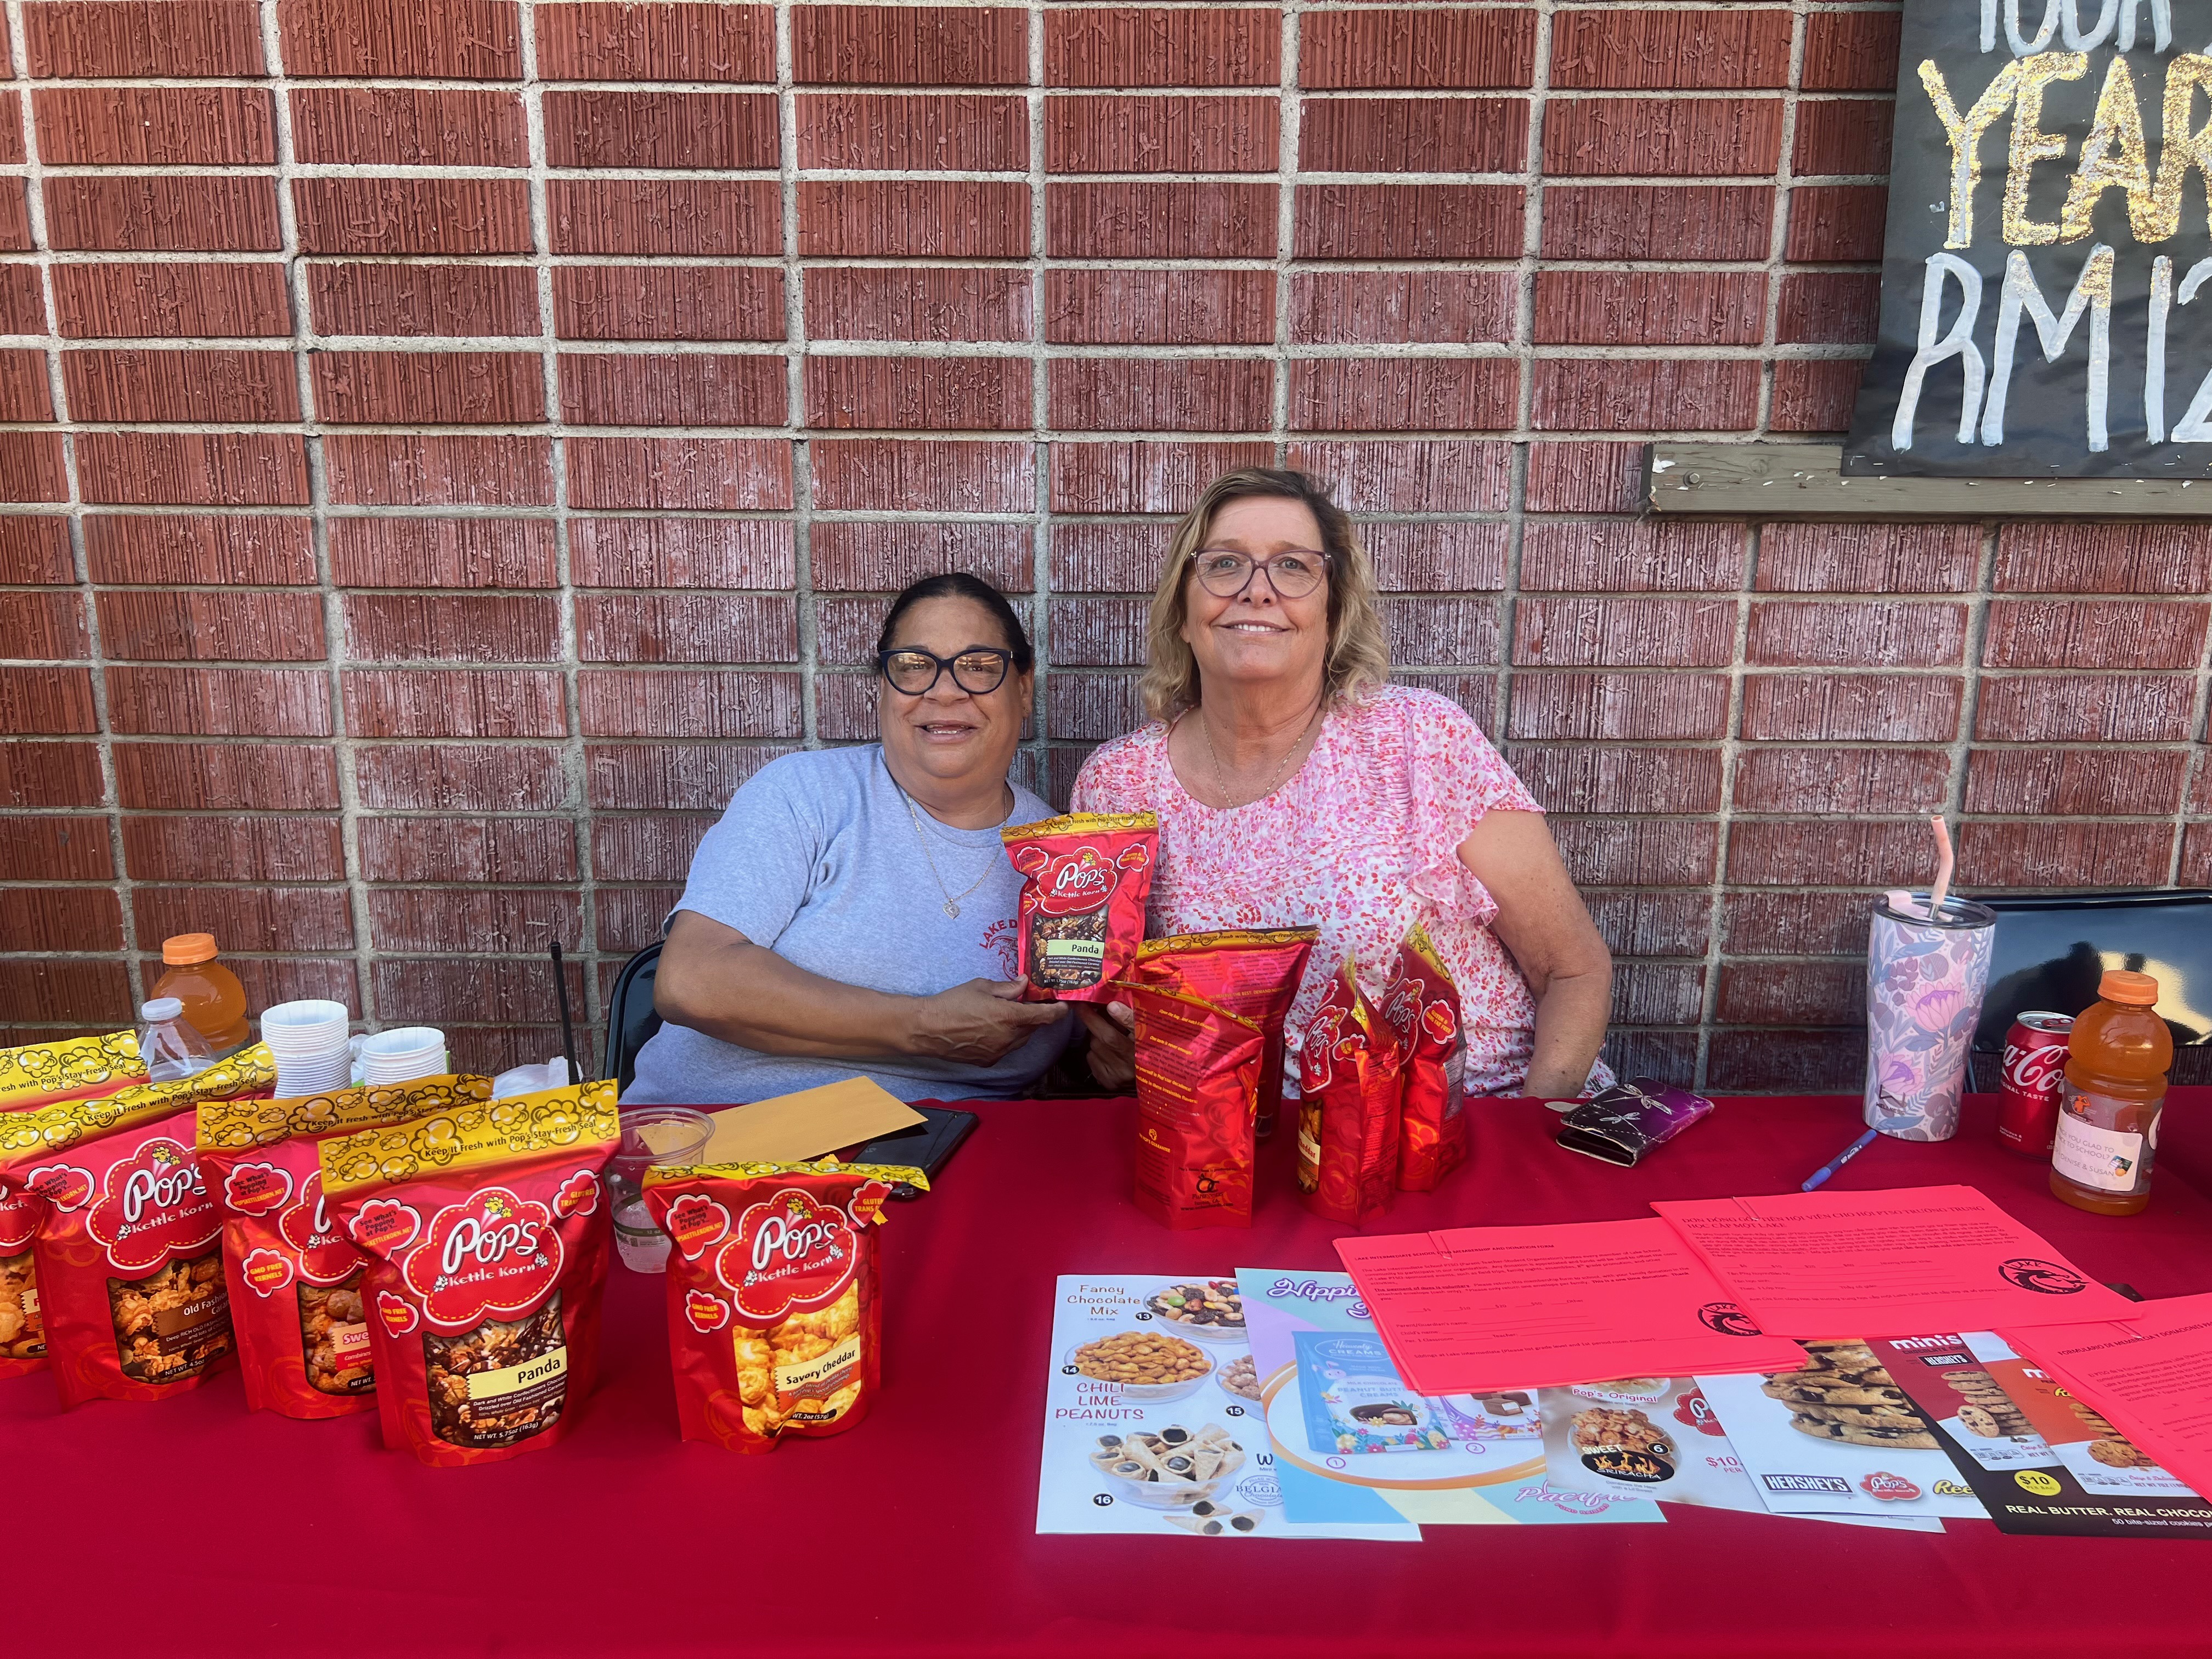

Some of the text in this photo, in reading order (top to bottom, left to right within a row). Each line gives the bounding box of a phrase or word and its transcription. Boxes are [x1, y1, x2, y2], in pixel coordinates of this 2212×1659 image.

[1056, 862, 1108, 889] Pop's
[1058, 890, 1080, 898] Kettle
[979, 920, 1007, 949] LAKE
[1071, 944, 1099, 953] Panda
[19, 1062, 126, 1088] with Pop's Stay-Fresh Seal
[88, 1076, 257, 1121] Keep Fresh with Pop's Stay-Fresh Seal
[2023, 1091, 2049, 1102] TASTE
[312, 1118, 336, 1127] Keep
[393, 1108, 414, 1117] Pop's
[425, 1120, 596, 1156] Keep Fresh with Pop's Stay-Fresh Seal
[2068, 1135, 2081, 1143] YOU
[2083, 1141, 2102, 1150] GLAD
[2076, 1146, 2110, 1160] SCHOOL?
[2061, 1154, 2081, 1167] DENISE
[2089, 1166, 2114, 1176] SUSAN
[132, 1201, 213, 1234] Kettle Korn
[374, 1210, 397, 1222] What's
[679, 1212, 707, 1224] Popping
[365, 1218, 395, 1231] Popping
[442, 1218, 541, 1274] Pop's
[752, 1216, 838, 1270] Pop's
[250, 1262, 283, 1275] GMO FREE
[449, 1263, 535, 1287] Kettle Korn
[759, 1256, 832, 1283] Kettle Korn
[254, 1271, 283, 1282] KERNELS
[1080, 1285, 1124, 1295] Fancy
[1067, 1295, 1141, 1304] Chocolate
[184, 1304, 199, 1316] Old
[1091, 1306, 1119, 1315] Mix
[1711, 1304, 1737, 1312] LAKE
[343, 1331, 369, 1345] Swe
[1888, 1334, 1963, 1350] minis
[1333, 1340, 1372, 1350] Heavenly
[1902, 1345, 1948, 1355] CHOCOLATE
[2058, 1344, 2104, 1356] FORMULARIO
[1924, 1354, 1968, 1365] HERSHEY'S
[165, 1367, 177, 1376] NET
[518, 1358, 561, 1384] Panda
[786, 1349, 855, 1384] Savory Cheddar
[1077, 1383, 1125, 1392] CHILI
[1079, 1395, 1121, 1406] LIME
[1572, 1389, 1603, 1398] Pop's
[1609, 1392, 1657, 1403] Original
[1056, 1408, 1144, 1419] PEANUTS
[499, 1428, 518, 1438] 5.75oz
[520, 1422, 538, 1432] (163g)
[1581, 1444, 1623, 1454] SWEET
[1596, 1468, 1662, 1480] SRIRACHA
[2019, 1476, 2050, 1485] $10
[1765, 1475, 1849, 1493] HERSHEY'S
[1871, 1476, 1908, 1489] Pop's
[1096, 1496, 1111, 1505] 16
[1555, 1503, 1577, 1515] FUND
[2005, 1505, 2212, 1519] REAL BUTTER. REAL CHOCO
